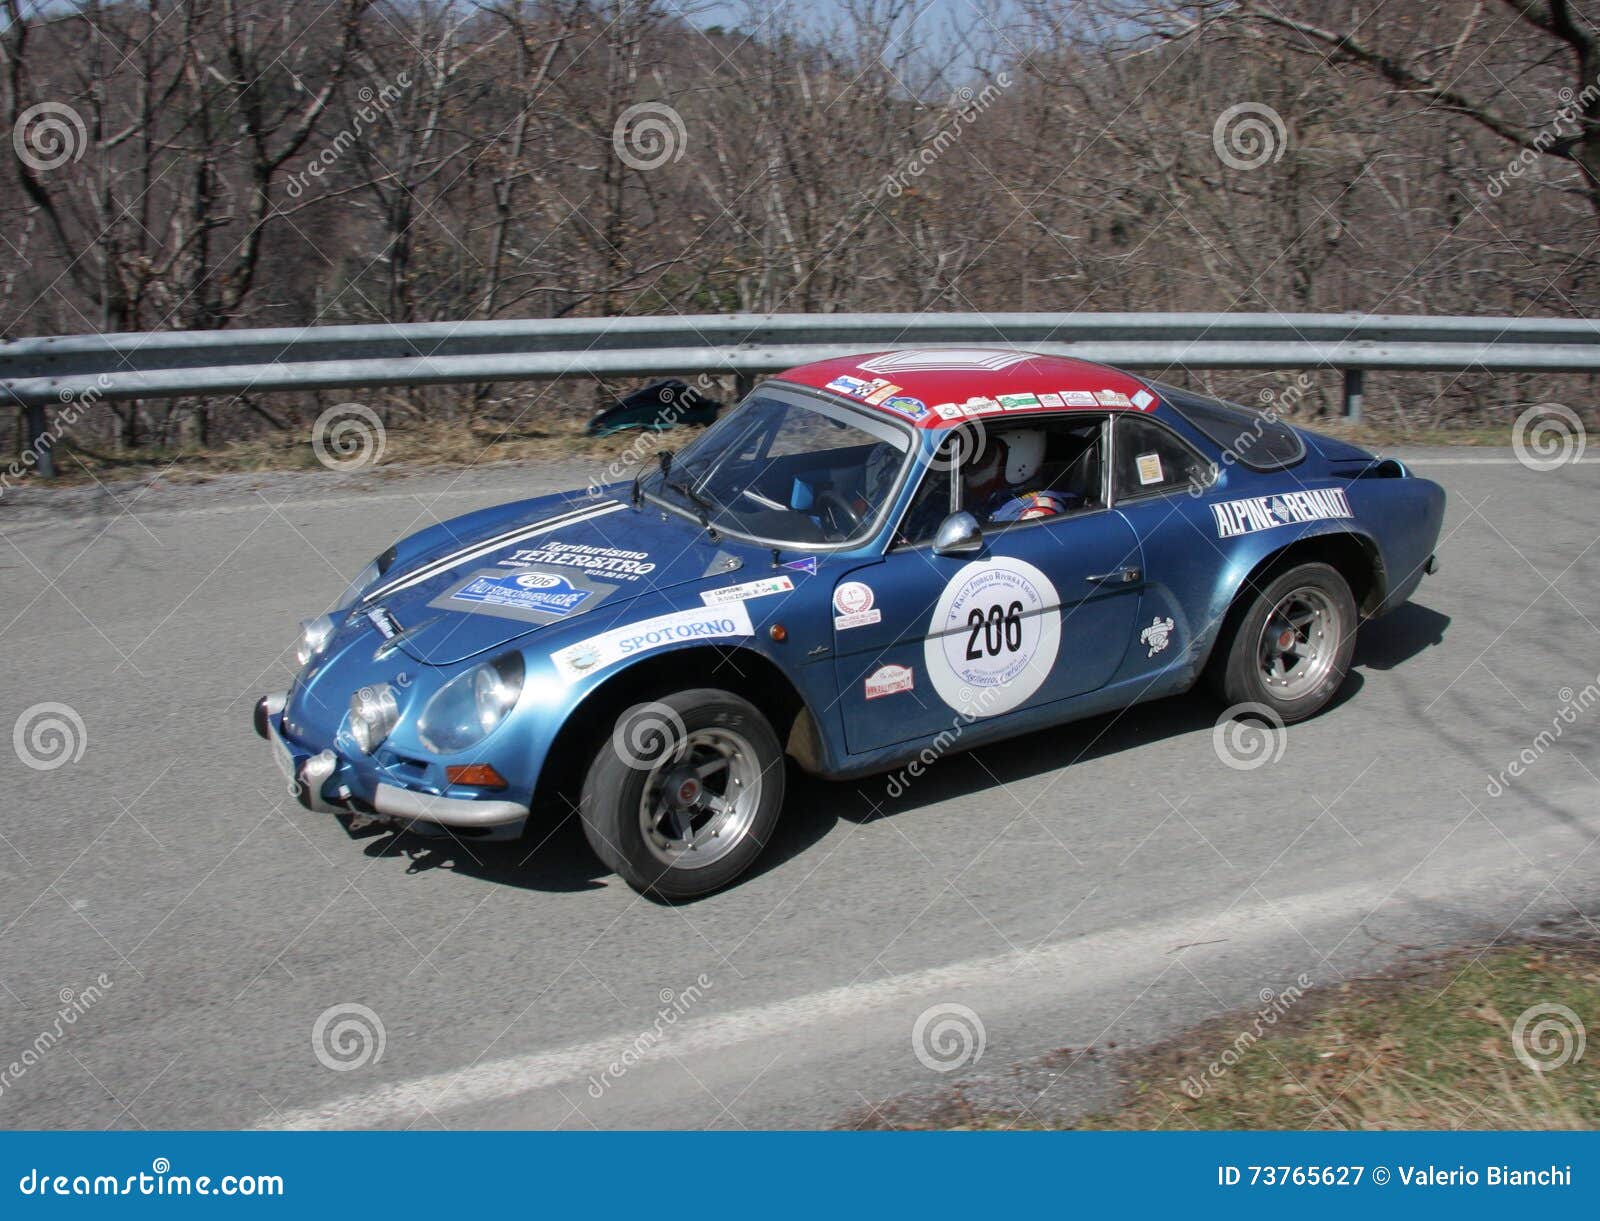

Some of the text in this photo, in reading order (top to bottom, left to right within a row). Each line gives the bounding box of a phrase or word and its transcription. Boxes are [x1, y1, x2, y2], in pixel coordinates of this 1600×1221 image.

[1214, 489, 1351, 536] ALPINE RENAULT
[523, 574, 552, 587] 206
[619, 619, 736, 654] SPOTORNO
[966, 600, 1024, 661] 206
